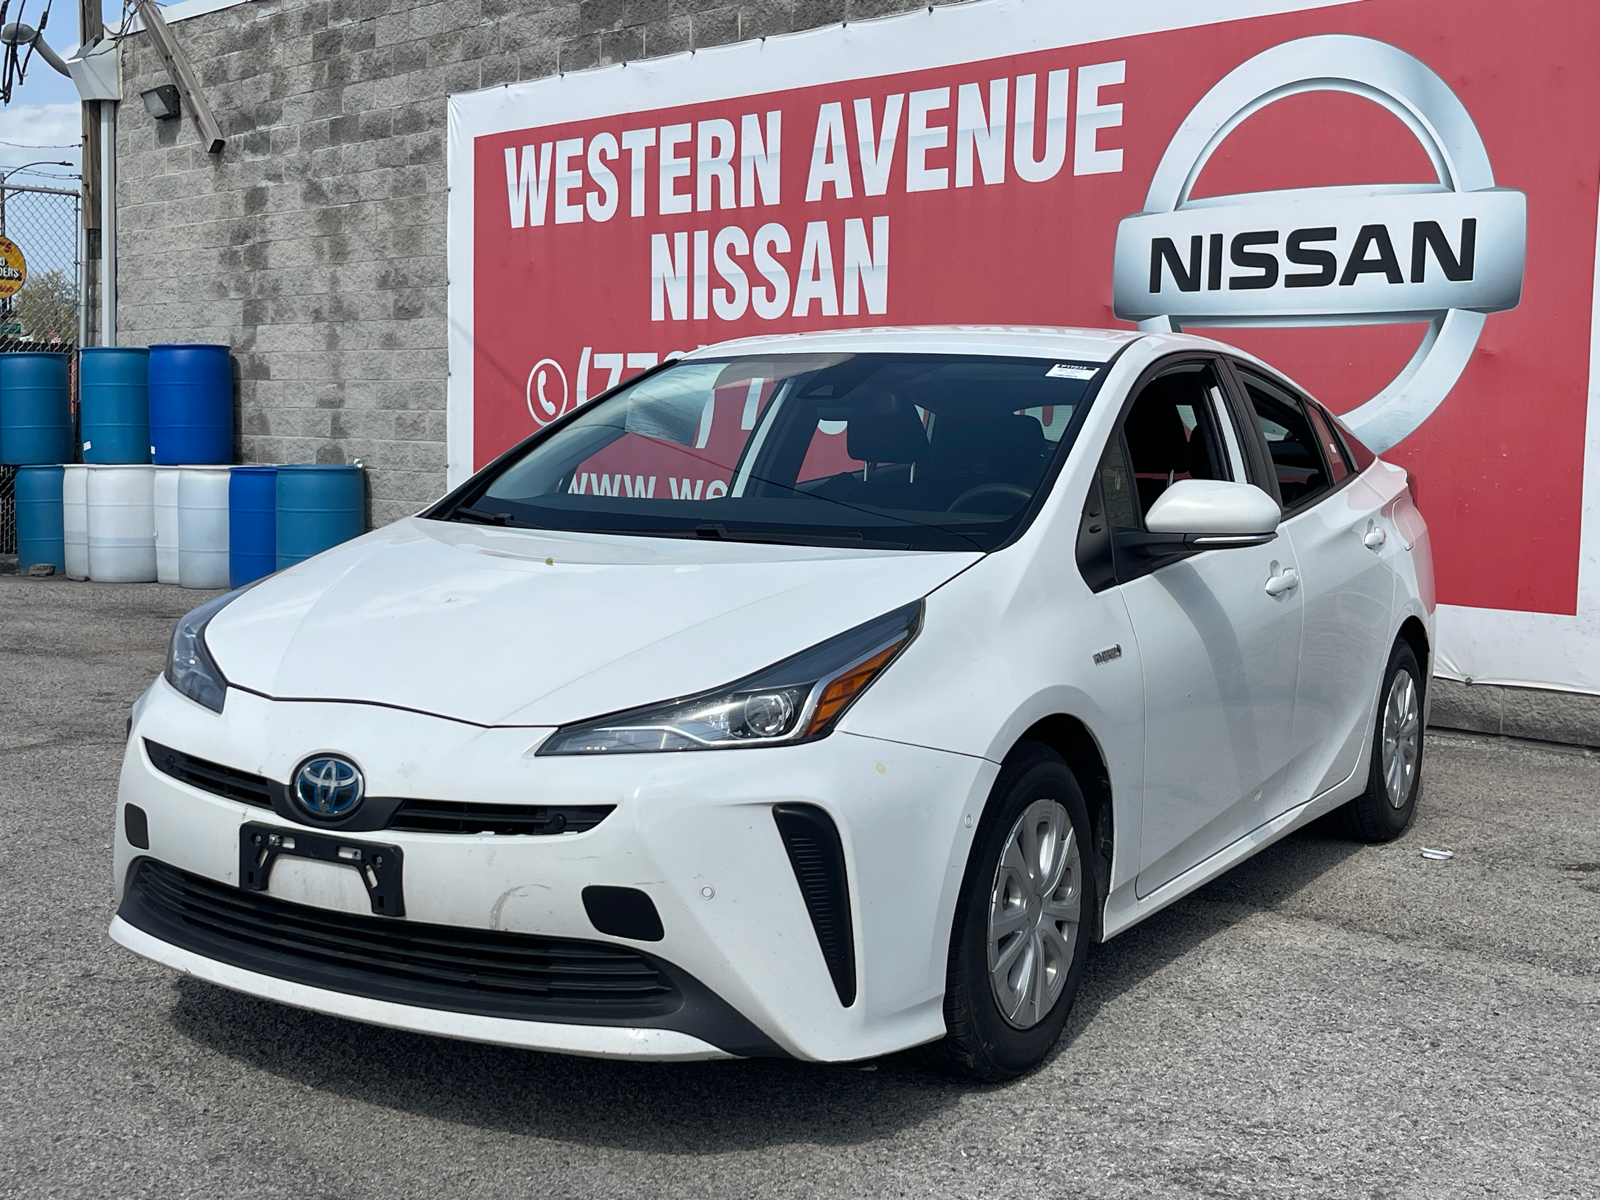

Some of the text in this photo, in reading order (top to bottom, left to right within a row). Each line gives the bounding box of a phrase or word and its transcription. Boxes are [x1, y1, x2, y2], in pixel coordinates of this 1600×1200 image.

[504, 60, 1126, 229] WESTERN AVENUE
[651, 215, 890, 321] NISSAN
[1149, 218, 1477, 294] NISSAN
